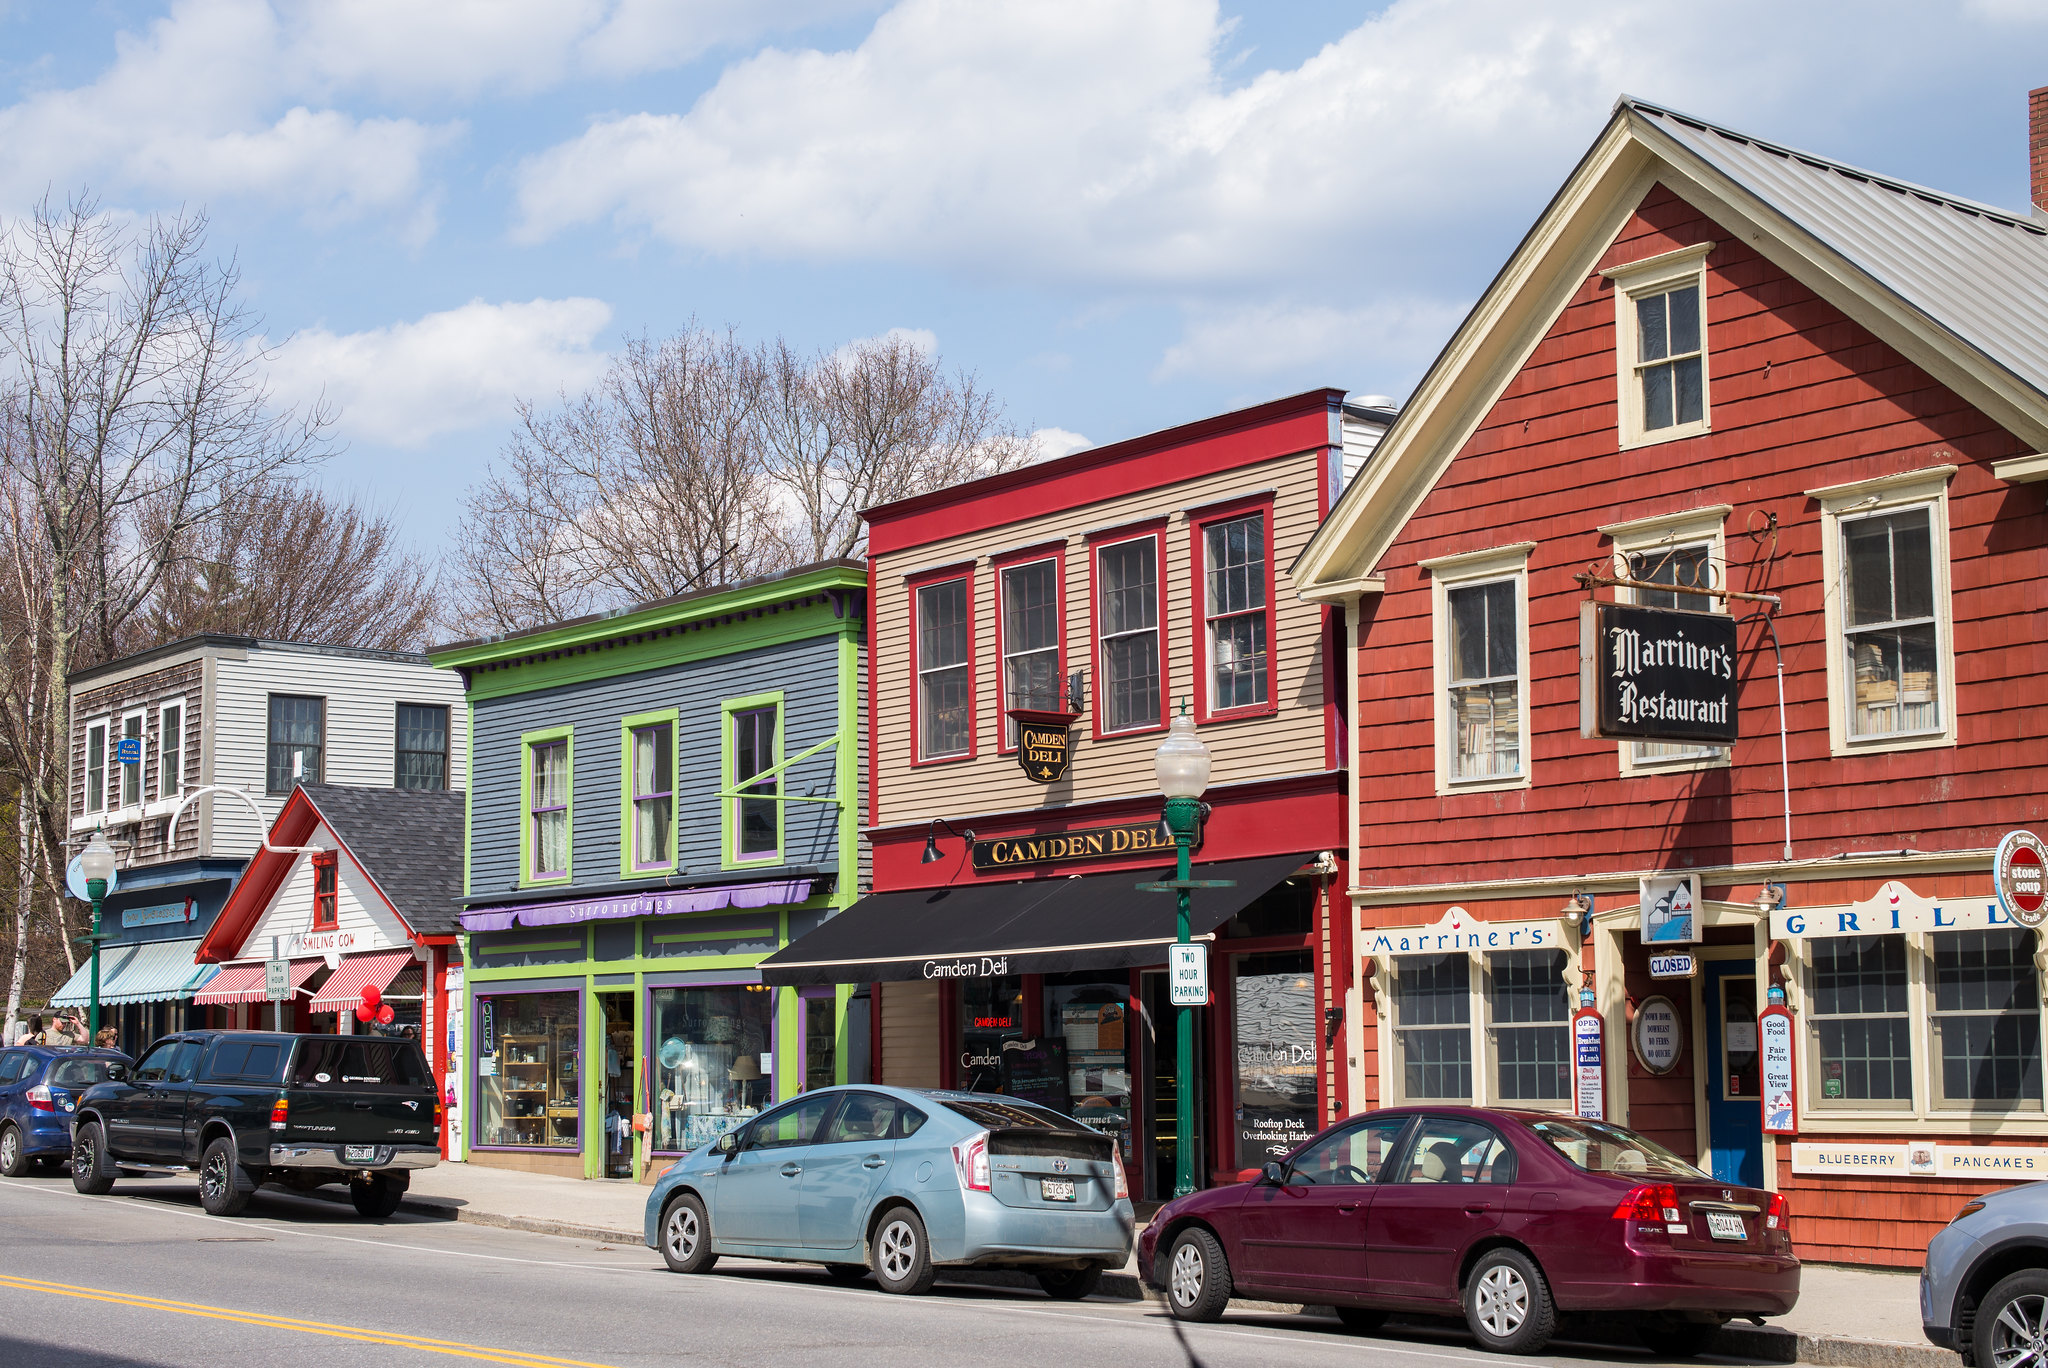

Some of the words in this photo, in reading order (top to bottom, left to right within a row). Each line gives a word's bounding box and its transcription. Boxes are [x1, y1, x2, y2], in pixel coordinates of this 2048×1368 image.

[1609, 627, 1732, 680] Marriner's
[1617, 680, 1728, 724] Restaurant
[1023, 730, 1066, 749] CAMDEN
[1028, 750, 1062, 763] DELI
[991, 833, 1105, 864] CAMDEN
[2002, 841, 2014, 879] second
[2016, 835, 2035, 846] hand
[2011, 866, 2041, 879] stone
[2015, 881, 2041, 894] soup
[570, 896, 673, 918] Surroundings
[2005, 891, 2018, 912] buy
[2021, 912, 2041, 923] trade
[302, 935, 334, 951] SMILING
[338, 933, 355, 947] COW
[1372, 927, 1543, 951] Marriner's
[1181, 952, 1195, 963] TWO
[272, 965, 283, 973] TWO
[923, 959, 977, 979] Camden
[980, 956, 1008, 977] Deli
[1651, 957, 1691, 973] CLOSED
[271, 975, 284, 983] HOUR
[1179, 969, 1198, 980] HOUR
[1174, 985, 1204, 997] PARKING
[999, 1017, 1012, 1027] DELI
[1645, 1012, 1658, 1021] DOWN
[484, 1003, 492, 1050] OPEN
[1766, 1020, 1786, 1028] Good
[1767, 1028, 1786, 1036] Food
[1768, 1046, 1785, 1054] Fair
[961, 1047, 1001, 1068] Camden
[1767, 1054, 1788, 1062] Price
[1582, 1067, 1595, 1075] Daily
[1768, 1080, 1788, 1088] View
[1253, 1118, 1284, 1130] Rooftop
[1284, 1118, 1305, 1129] Deck
[1242, 1130, 1288, 1143] Overlooking
[1818, 1154, 1896, 1165] BLUEBERRY
[1952, 1156, 2035, 1169] PANCAKES
[1047, 1183, 1064, 1195] 6725
